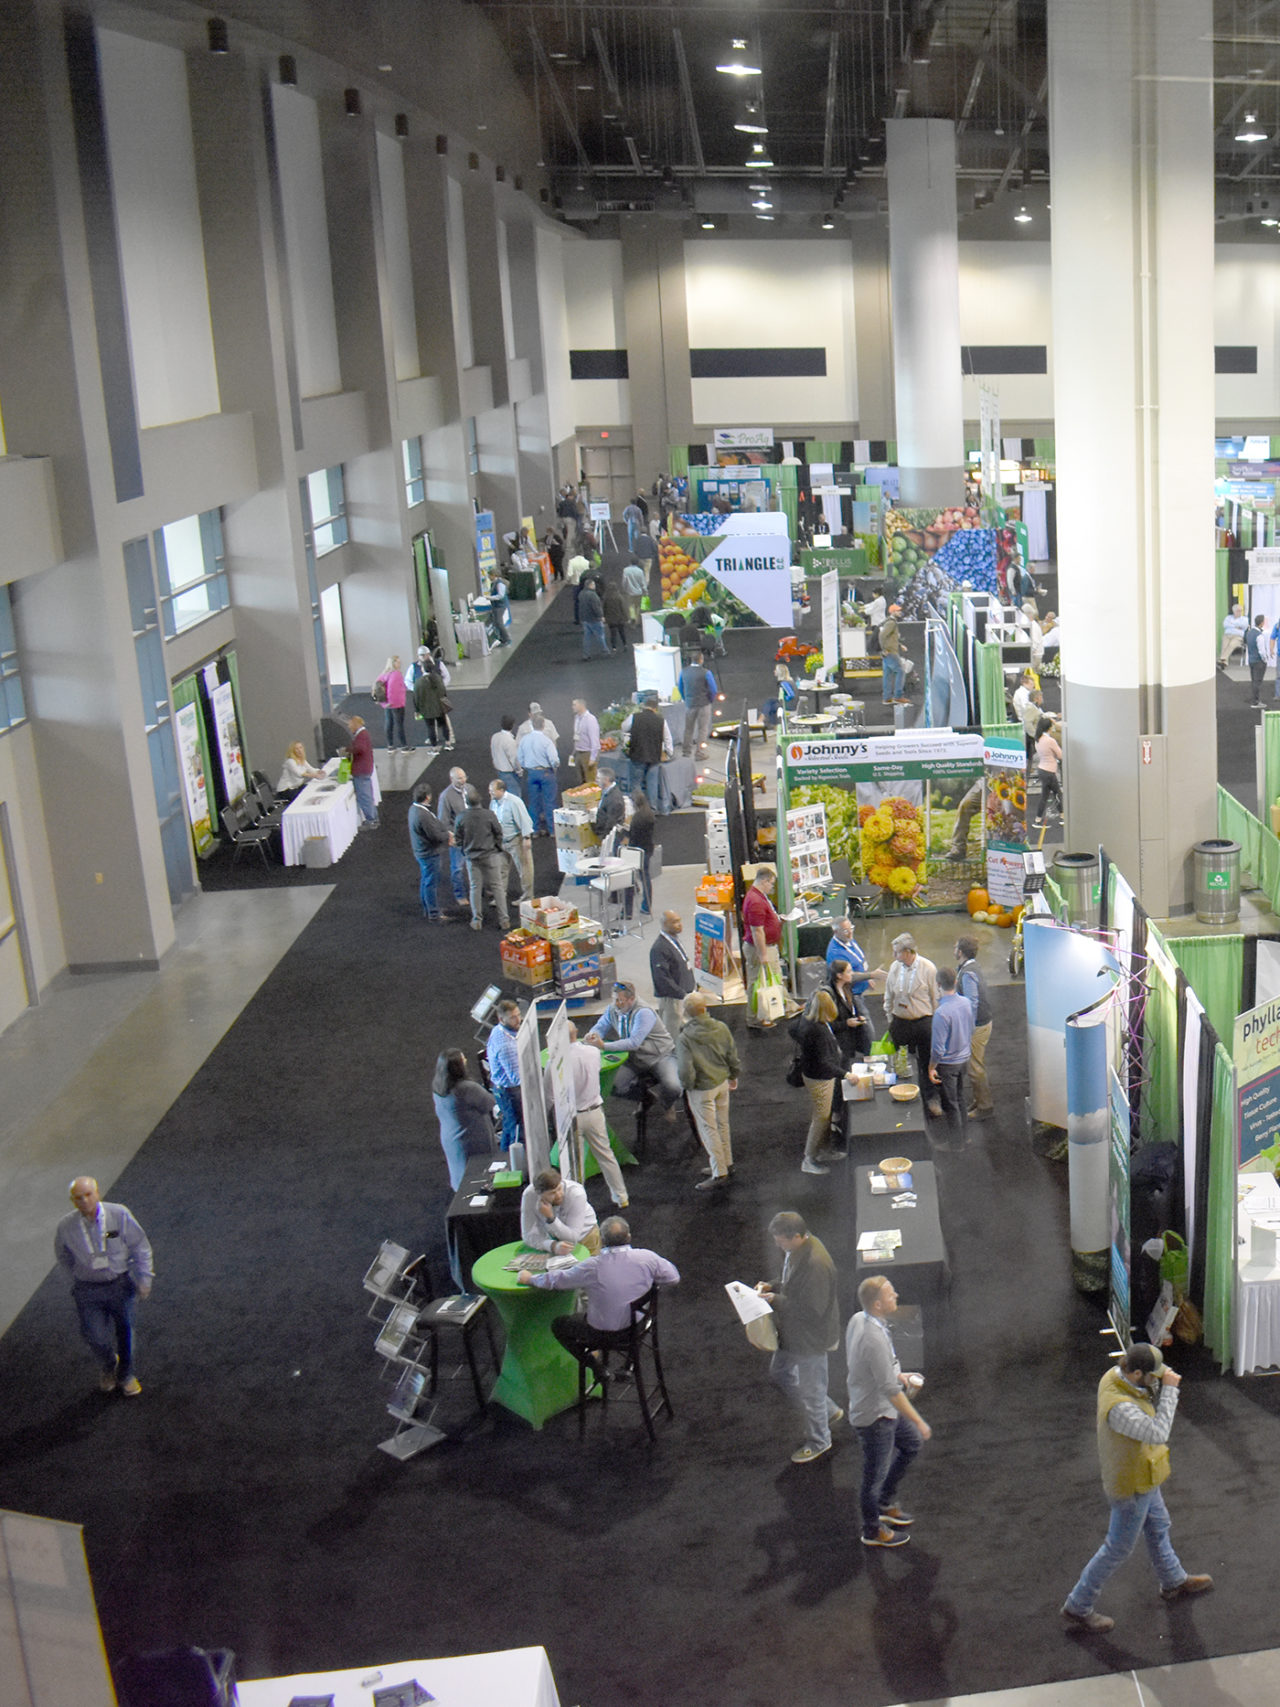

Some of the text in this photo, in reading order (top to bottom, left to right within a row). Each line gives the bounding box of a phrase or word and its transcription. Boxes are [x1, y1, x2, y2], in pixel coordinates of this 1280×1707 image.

[715, 556, 776, 572] TRIANGLE
[804, 742, 868, 757] Johnny's
[991, 751, 1024, 762] Johnny's
[1253, 1086, 1270, 1100] Quality
[1243, 1097, 1277, 1120] Tissue Culture
[1254, 1130, 1269, 1142] Berry
